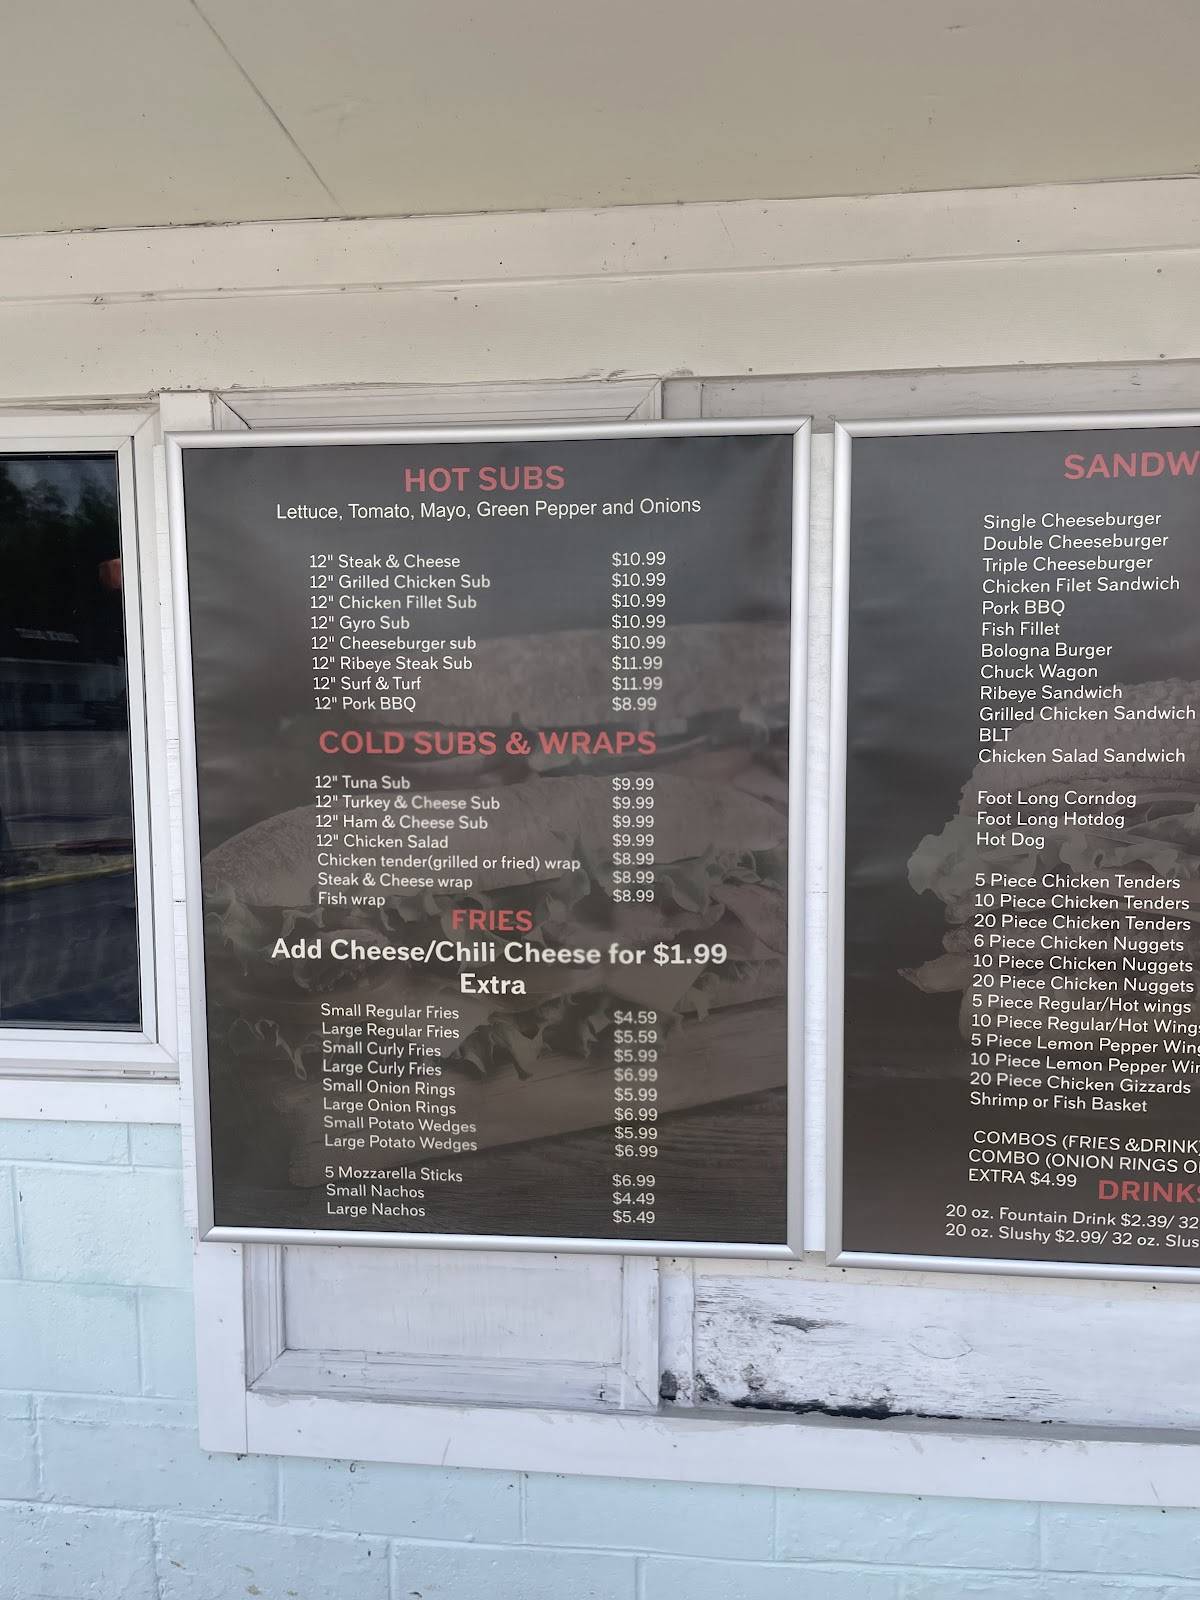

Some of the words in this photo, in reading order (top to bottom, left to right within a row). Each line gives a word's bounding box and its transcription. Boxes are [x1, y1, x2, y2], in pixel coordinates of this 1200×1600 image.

[1065, 452, 1200, 479] SANDW
[405, 467, 469, 493] HOT
[480, 466, 564, 490] SUBS
[277, 504, 342, 521] Lettuce,
[348, 503, 414, 520] Tomato,
[420, 502, 470, 522] Mayo,
[476, 501, 529, 517] Green
[535, 500, 598, 520] Pepper
[602, 498, 634, 515] and
[640, 497, 702, 514] Onions
[984, 514, 1036, 532] Single
[1042, 512, 1162, 528] Cheeseburger
[310, 554, 333, 568] 12"
[338, 554, 382, 568] Steak
[386, 554, 400, 568] &
[404, 554, 460, 568] Cheese
[612, 551, 666, 568] $10.99
[982, 557, 1028, 575] Triple
[1033, 555, 1153, 572] Cheeseburger
[310, 595, 334, 609] 12"
[339, 595, 401, 609] Chicken
[406, 595, 442, 609] Fillet
[447, 594, 477, 609] Sub
[612, 592, 666, 609] $10.99
[982, 600, 1020, 615] Pork
[1025, 599, 1065, 617] BBQ
[311, 636, 334, 650] 12"
[340, 635, 446, 653] Cheeseburger
[450, 636, 476, 650] sub
[612, 634, 666, 650] $10.99
[982, 643, 1050, 660] Bologna
[1056, 642, 1113, 660] Burger
[980, 664, 1034, 679] Chuck
[1038, 664, 1098, 681] Wagon
[313, 676, 336, 690] 12"
[340, 676, 372, 690] Surf
[375, 676, 390, 690] &
[392, 676, 422, 690] Turf
[612, 676, 662, 691] $11.99
[980, 685, 1036, 703] Ribeye
[1042, 684, 1122, 700] Sandwich
[319, 730, 405, 753] COLD
[413, 732, 497, 755] SUBS
[506, 732, 529, 754] &
[540, 731, 656, 754] WRAPS
[980, 728, 1012, 742] BLT
[978, 748, 1046, 763] Chicken
[1052, 748, 1098, 763] Salad
[1104, 748, 1185, 762] Sandwich
[315, 775, 338, 788] 12"
[342, 775, 378, 789] Tuna
[381, 775, 410, 789] Sub
[612, 776, 654, 792] $9.99
[978, 790, 1012, 804] Foot
[1018, 790, 1058, 808] Long
[1064, 790, 1137, 808] Corndog
[316, 814, 338, 828] 12"
[343, 814, 378, 828] Ham
[382, 814, 396, 828] &
[399, 814, 455, 829] Cheese
[458, 815, 488, 830] Sub
[612, 814, 654, 829] $9.99
[976, 832, 1006, 846] Hot
[1012, 832, 1044, 850] Dog
[318, 852, 376, 867] Chicken
[381, 854, 478, 871] tender(grilled
[482, 859, 498, 869] or
[501, 855, 540, 872] fried)
[544, 860, 581, 872] wrap
[612, 852, 654, 866] $8.99
[975, 873, 986, 886] 5
[991, 873, 1037, 888] Piece
[1042, 874, 1110, 888] Chicken
[1114, 874, 1180, 889] Tenders
[318, 891, 347, 905] Fish
[351, 896, 386, 908] wrap
[612, 888, 654, 903] $8.99
[452, 909, 532, 932] FRIES
[974, 913, 996, 928] 20
[1002, 914, 1048, 929] Piece
[1052, 914, 1120, 930] Chicken
[1125, 916, 1191, 931] Tenders
[271, 937, 322, 959] Add
[330, 938, 495, 963] Cheese/Chili
[504, 941, 601, 964] Cheese
[608, 942, 646, 964] for
[653, 942, 727, 967] $1.99
[973, 954, 993, 968] 10
[998, 954, 1044, 969] Piece
[1049, 956, 1116, 970] Chicken
[1122, 956, 1193, 975] Nuggets
[460, 973, 527, 995] Extra
[320, 1002, 361, 1017] Small
[366, 1004, 422, 1021] Regular
[426, 1005, 459, 1020] Fries
[972, 994, 982, 1007] 5
[988, 994, 1034, 1010] Piece
[1038, 996, 1139, 1014] Regular/Hot
[1144, 999, 1192, 1016] wings
[614, 1010, 657, 1025] $4.59
[322, 1040, 362, 1054] Small
[366, 1041, 404, 1058] Curly
[408, 1043, 441, 1057] Fries
[614, 1048, 658, 1063] $5.99
[322, 1078, 362, 1092] Small
[367, 1079, 410, 1094] Onion
[415, 1081, 456, 1098] Rings
[970, 1071, 992, 1086] 20
[997, 1072, 1042, 1088] Piece
[1047, 1075, 1114, 1091] Chicken
[1120, 1078, 1191, 1094] Gizzards
[614, 1086, 658, 1102] $5.99
[970, 1091, 1028, 1110] Shrimp
[1032, 1098, 1049, 1108] or
[1054, 1095, 1086, 1110] Fish
[1092, 1096, 1148, 1112] Basket
[324, 1115, 364, 1128] Small
[368, 1116, 414, 1130] Potato
[418, 1118, 476, 1135] Wedges
[614, 1126, 658, 1140] $5.99
[974, 1130, 1057, 1147] COMBOS
[1062, 1134, 1120, 1150] (FRIES
[968, 1148, 1040, 1166] COMBO
[1045, 1152, 1114, 1170] (ONION
[1119, 1156, 1178, 1172] RINGS
[1183, 1160, 1200, 1174] O
[325, 1166, 334, 1178] 5
[338, 1166, 417, 1180] Mozzarella
[420, 1167, 463, 1182] Sticks
[612, 1173, 656, 1188] $6.99
[968, 1168, 1026, 1184] EXTRA
[1030, 1170, 1077, 1188] $4.99
[327, 1202, 368, 1218] Large
[372, 1202, 426, 1217] Nachos
[612, 1209, 655, 1224] $5.49
[946, 1204, 967, 1218] 20
[971, 1208, 994, 1219] oz.
[1000, 1206, 1067, 1224] Fountain
[1072, 1211, 1116, 1226] Drink
[1120, 1212, 1175, 1229] $2.39/
[1178, 1216, 1199, 1229] 32
[945, 1223, 966, 1237] 20
[971, 1228, 993, 1238] oz.
[998, 1226, 1051, 1244] Slushy
[1054, 1228, 1109, 1245] $2.99/
[1112, 1232, 1132, 1245] 32
[1137, 1236, 1160, 1246] oz.
